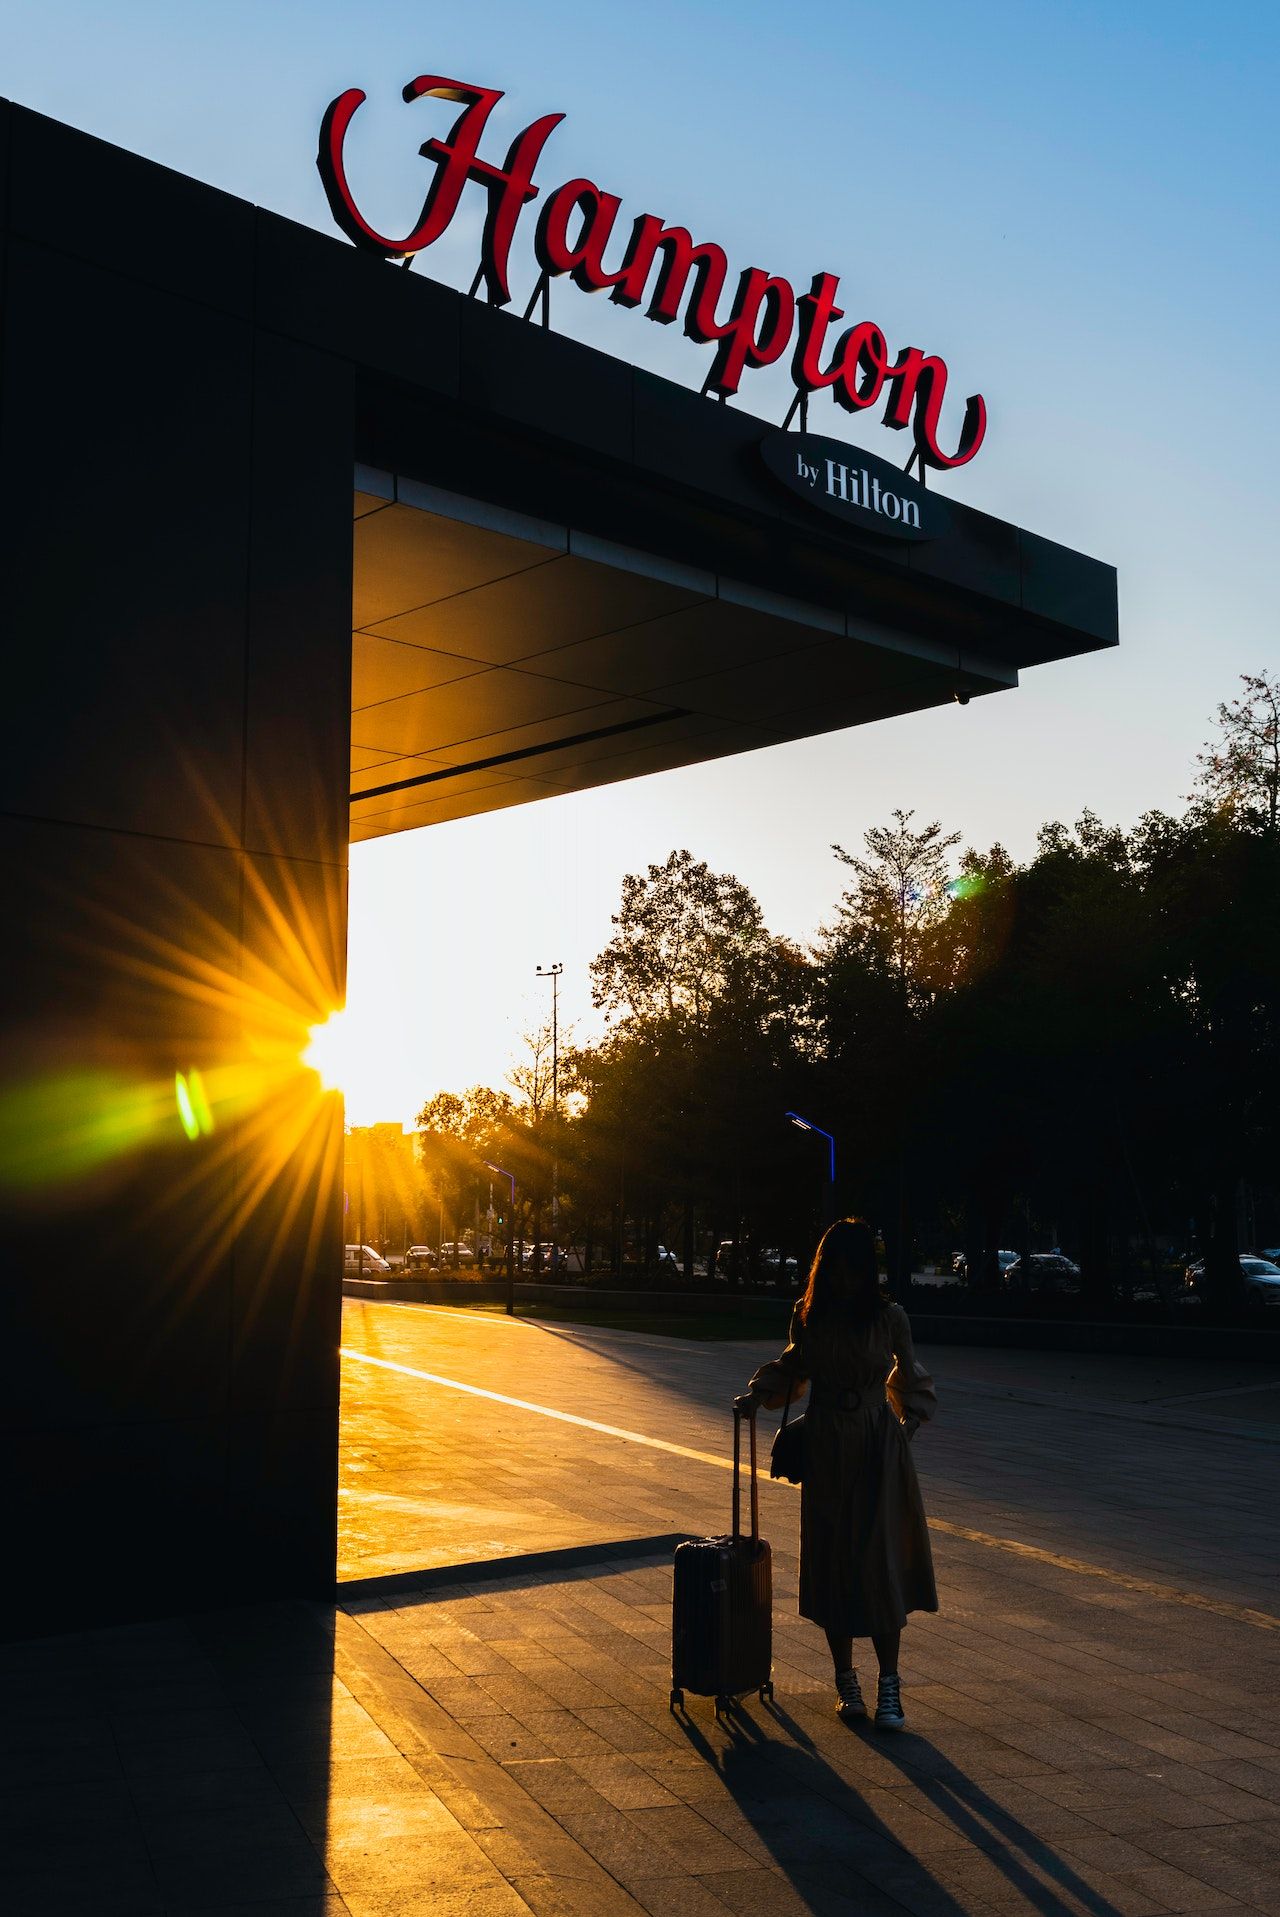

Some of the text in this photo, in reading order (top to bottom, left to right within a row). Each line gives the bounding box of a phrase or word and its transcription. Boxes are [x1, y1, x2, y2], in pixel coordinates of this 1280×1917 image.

[317, 75, 986, 469] Hampton
[796, 453, 922, 529] by Hilton
